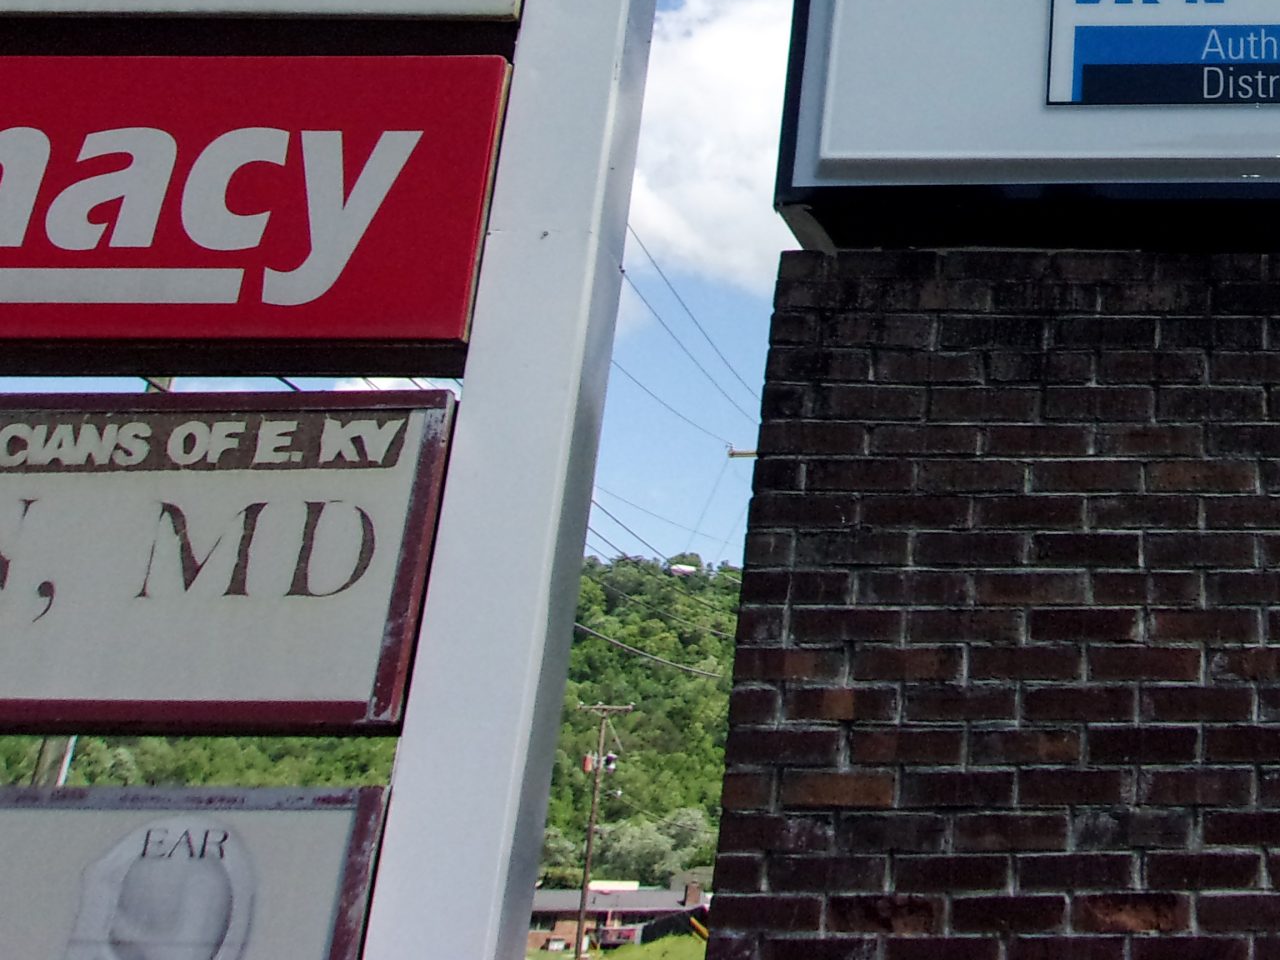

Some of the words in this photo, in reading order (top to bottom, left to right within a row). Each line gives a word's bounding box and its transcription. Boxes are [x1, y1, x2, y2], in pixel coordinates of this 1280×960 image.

[0, 421, 152, 466] CIANS
[166, 420, 246, 465] OF
[252, 420, 303, 464] E.
[318, 418, 405, 464] KY
[134, 500, 375, 598] MD
[141, 828, 230, 860] EAR
